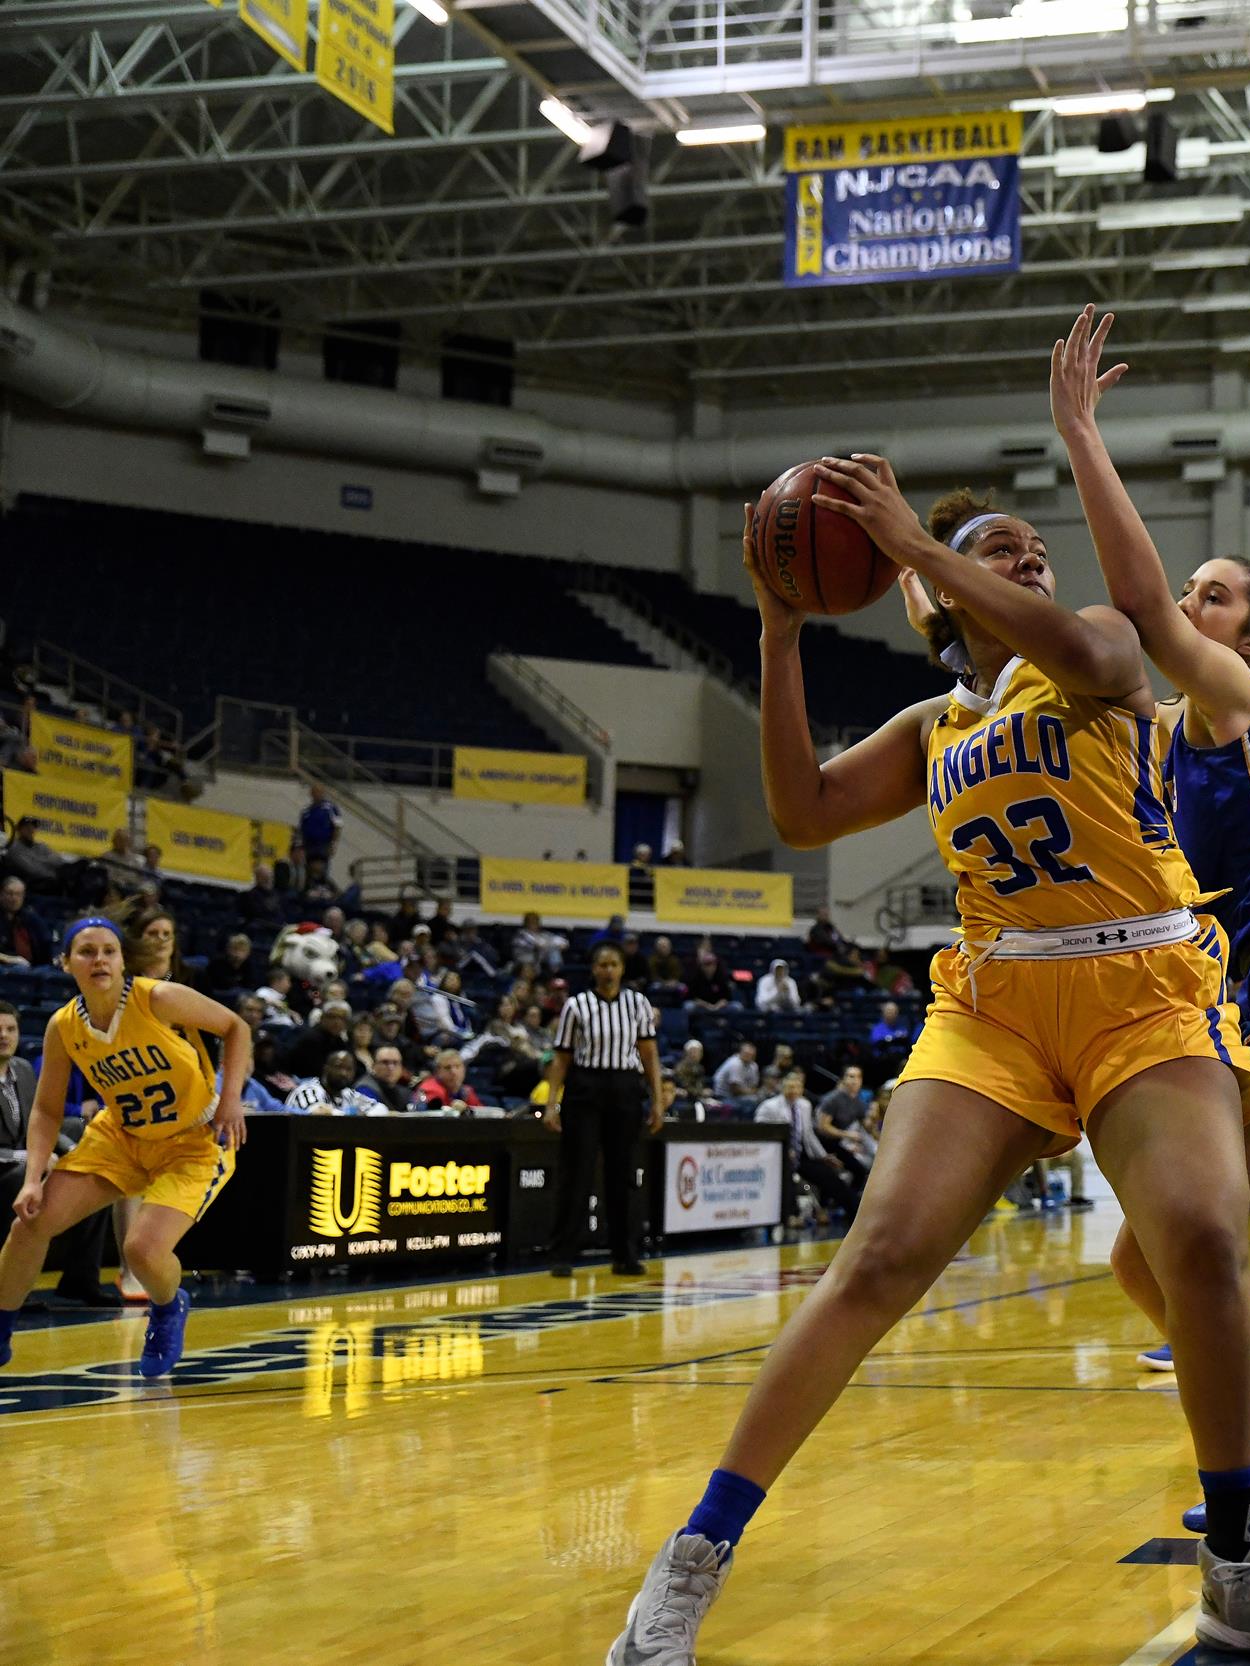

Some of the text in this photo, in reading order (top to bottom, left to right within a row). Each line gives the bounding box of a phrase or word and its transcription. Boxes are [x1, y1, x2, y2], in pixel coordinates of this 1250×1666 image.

[794, 123, 1010, 162] RAM BASKETBALL
[834, 160, 1001, 202] NJCAA
[848, 198, 988, 239] National
[824, 234, 1012, 276] Champions
[773, 497, 804, 600] Wilson
[928, 711, 1073, 829] ANGELO
[951, 796, 1097, 897] 32
[1131, 925, 1171, 938] ARMOUR
[90, 1045, 172, 1090] ANGELO
[115, 1081, 178, 1128] 22
[388, 1160, 491, 1198] Foster
